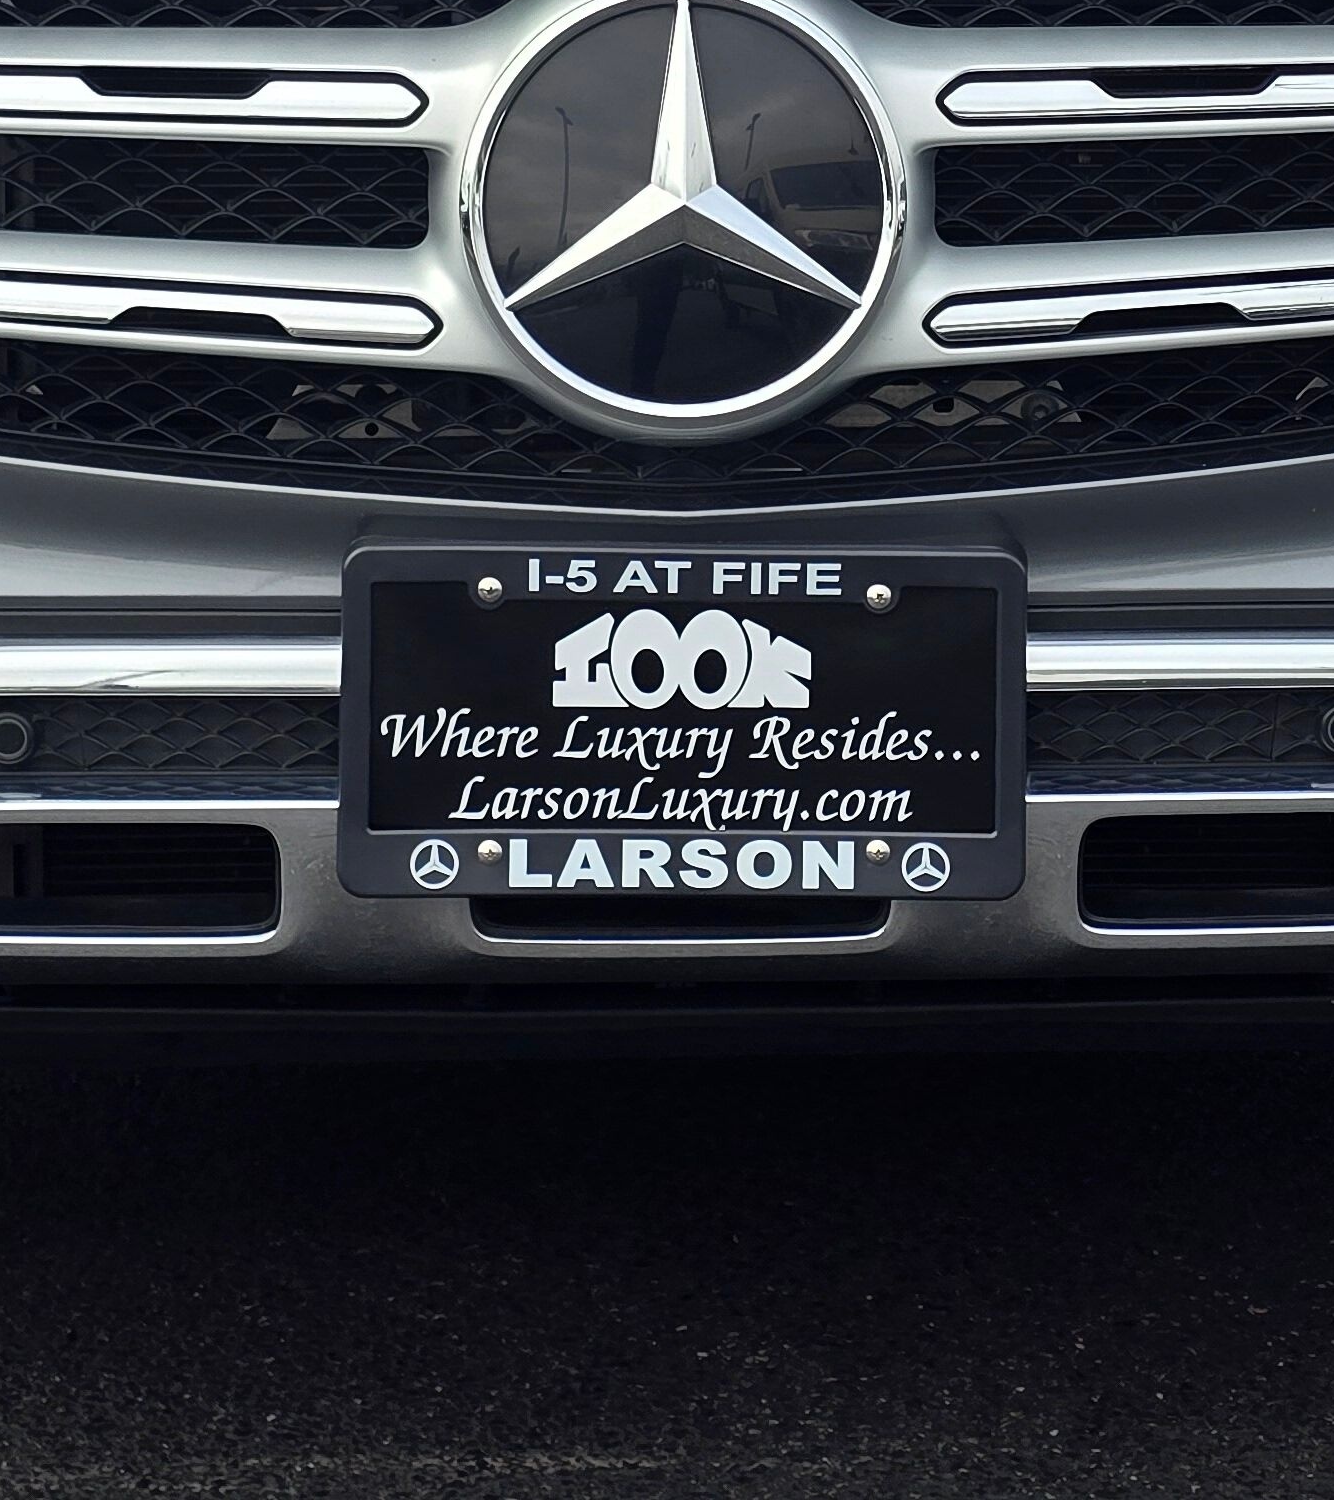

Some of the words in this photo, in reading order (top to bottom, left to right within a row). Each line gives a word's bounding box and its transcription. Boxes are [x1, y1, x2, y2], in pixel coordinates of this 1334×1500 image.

[528, 558, 598, 593] I-5
[612, 560, 692, 594] AT
[712, 561, 843, 596] FIFE
[380, 707, 539, 758] Where
[552, 715, 734, 779] Luxury
[748, 710, 981, 770] Resides...
[447, 775, 914, 832] LarsonLuxury.com
[508, 838, 855, 890] LARSON
